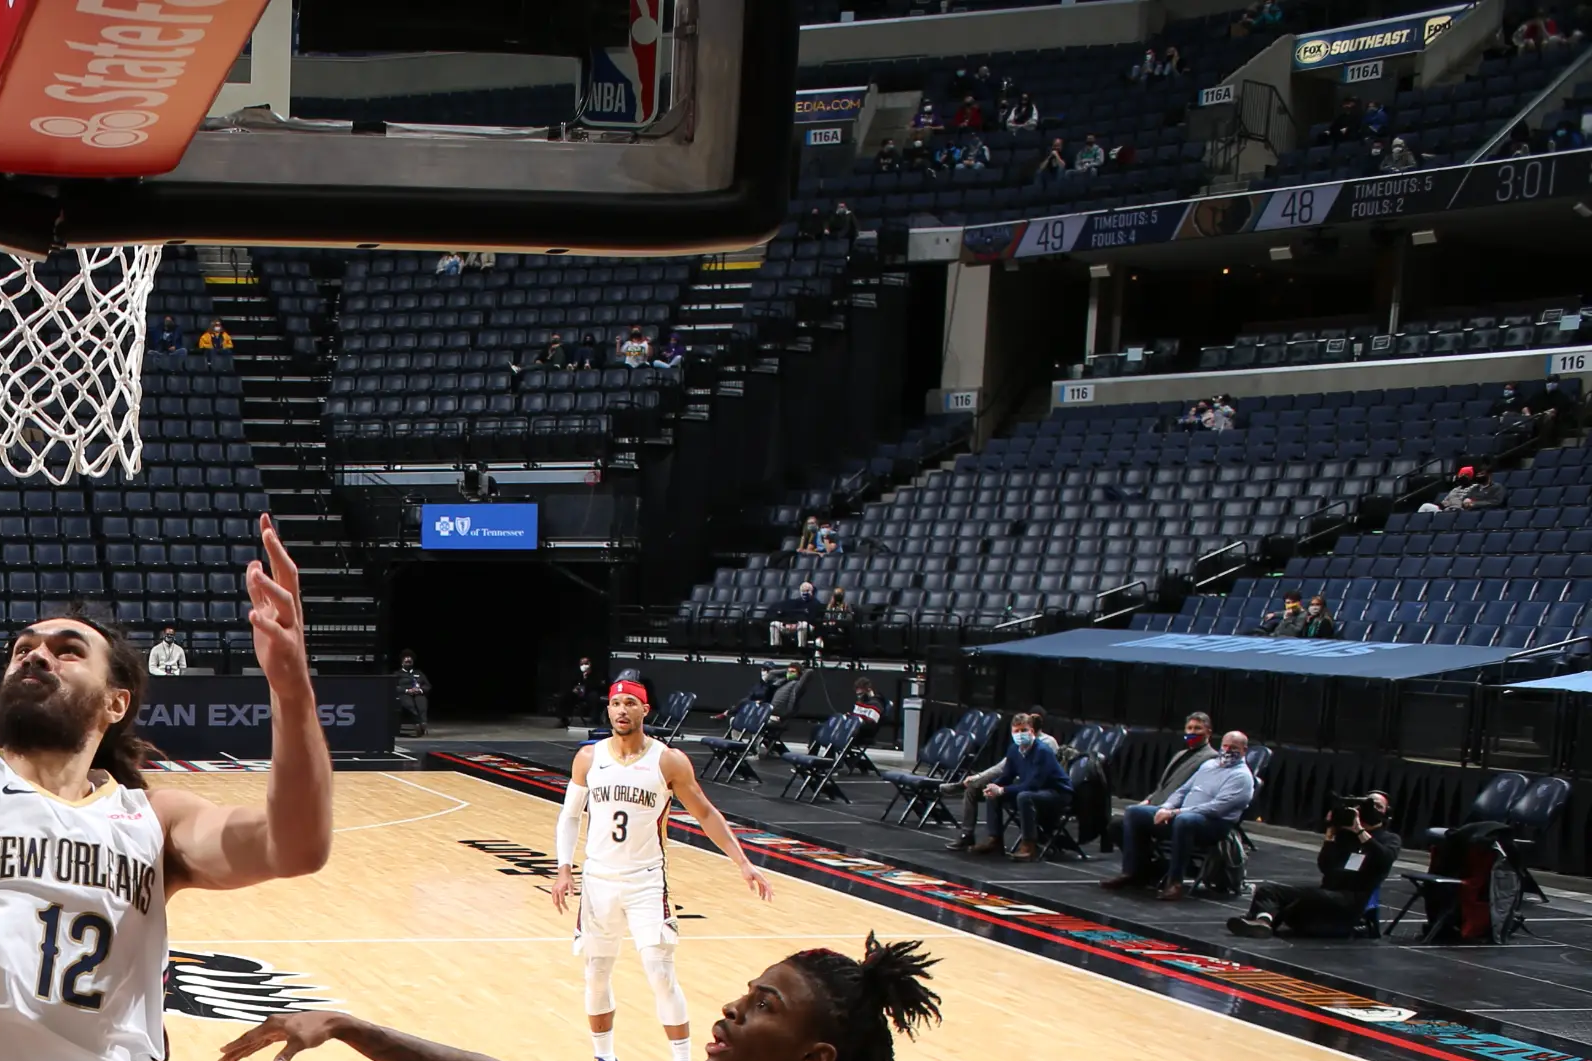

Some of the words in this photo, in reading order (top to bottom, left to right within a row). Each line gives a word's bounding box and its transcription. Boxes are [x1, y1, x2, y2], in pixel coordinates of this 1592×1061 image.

[1330, 29, 1411, 56] SOUTHEAST
[1349, 63, 1380, 80] 116A
[588, 81, 626, 113] NBA
[795, 98, 861, 113] EDIA.COM
[1204, 87, 1231, 103] 116A
[812, 130, 839, 143] 116A
[1354, 178, 1421, 200] TIMEOUTS:
[1424, 176, 1433, 192] 5
[1495, 159, 1557, 201] 3:01
[1280, 189, 1315, 225] 48
[1351, 200, 1395, 218] FOULS:
[1396, 198, 1404, 212] 2
[1093, 211, 1149, 231] TIMEOUTS:
[1150, 210, 1158, 225] 5
[1036, 220, 1064, 252] 49
[1091, 233, 1128, 248] FOULS:
[1128, 231, 1137, 244] 4
[1560, 355, 1585, 371] 116
[954, 395, 971, 406] 116
[1069, 387, 1088, 400] 116
[470, 528, 480, 537] of
[481, 528, 525, 537] Tennessee
[208, 703, 356, 727] EXPSS
[591, 785, 611, 803] NEW
[613, 785, 658, 808] ORLEANS
[611, 810, 629, 843] 3
[56, 838, 156, 915] ORLEANS
[35, 902, 115, 1013] 12
